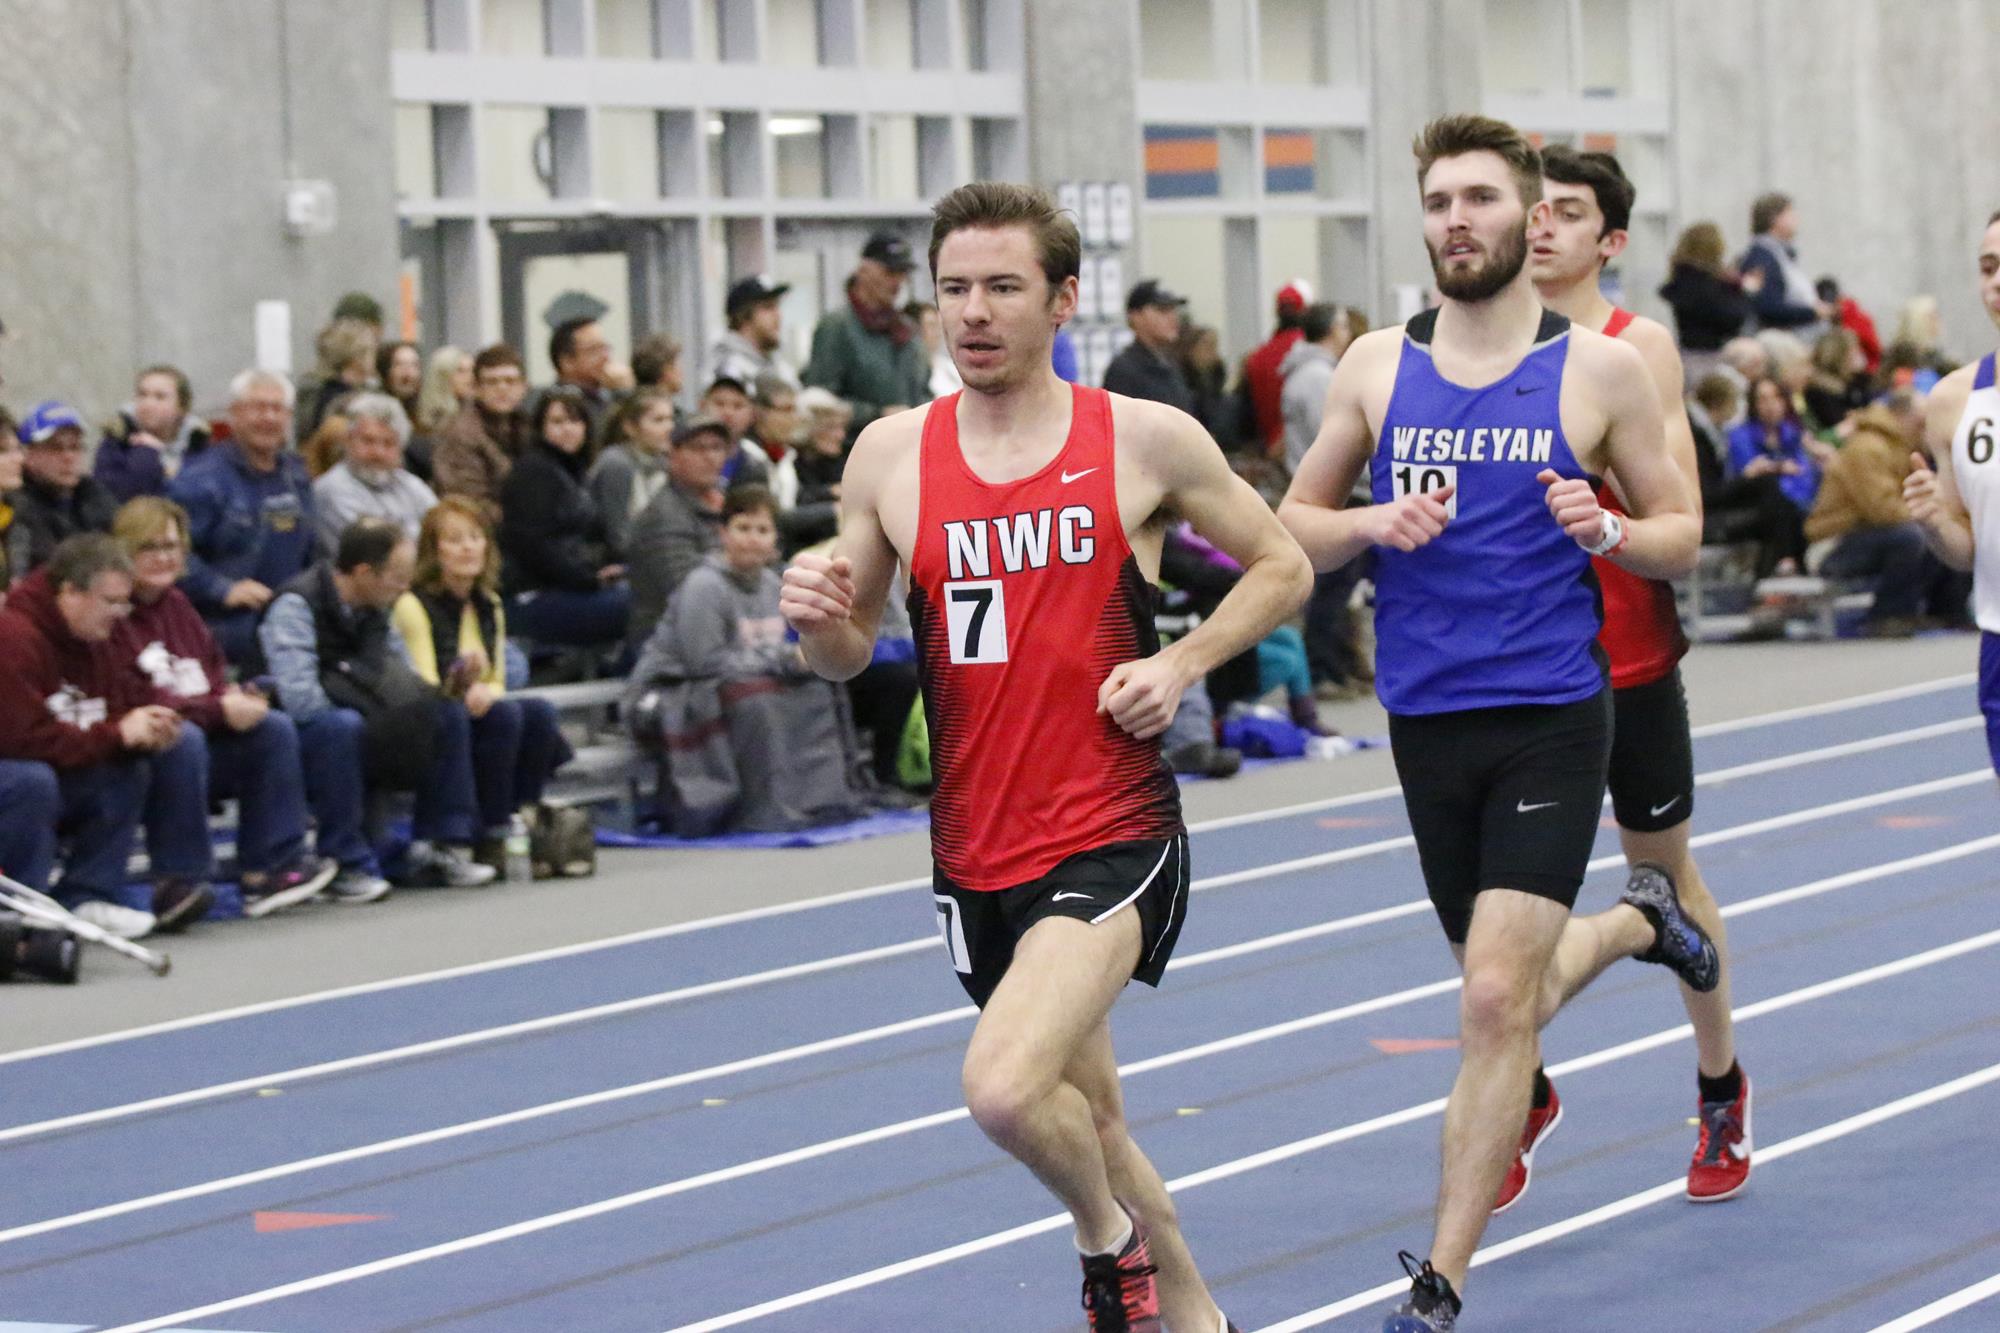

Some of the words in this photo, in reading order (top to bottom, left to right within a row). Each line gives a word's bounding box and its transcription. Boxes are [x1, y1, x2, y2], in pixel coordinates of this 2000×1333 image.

[1393, 426, 1553, 462] WESLEYAN
[942, 504, 1095, 580] NWC
[951, 588, 993, 658] 7
